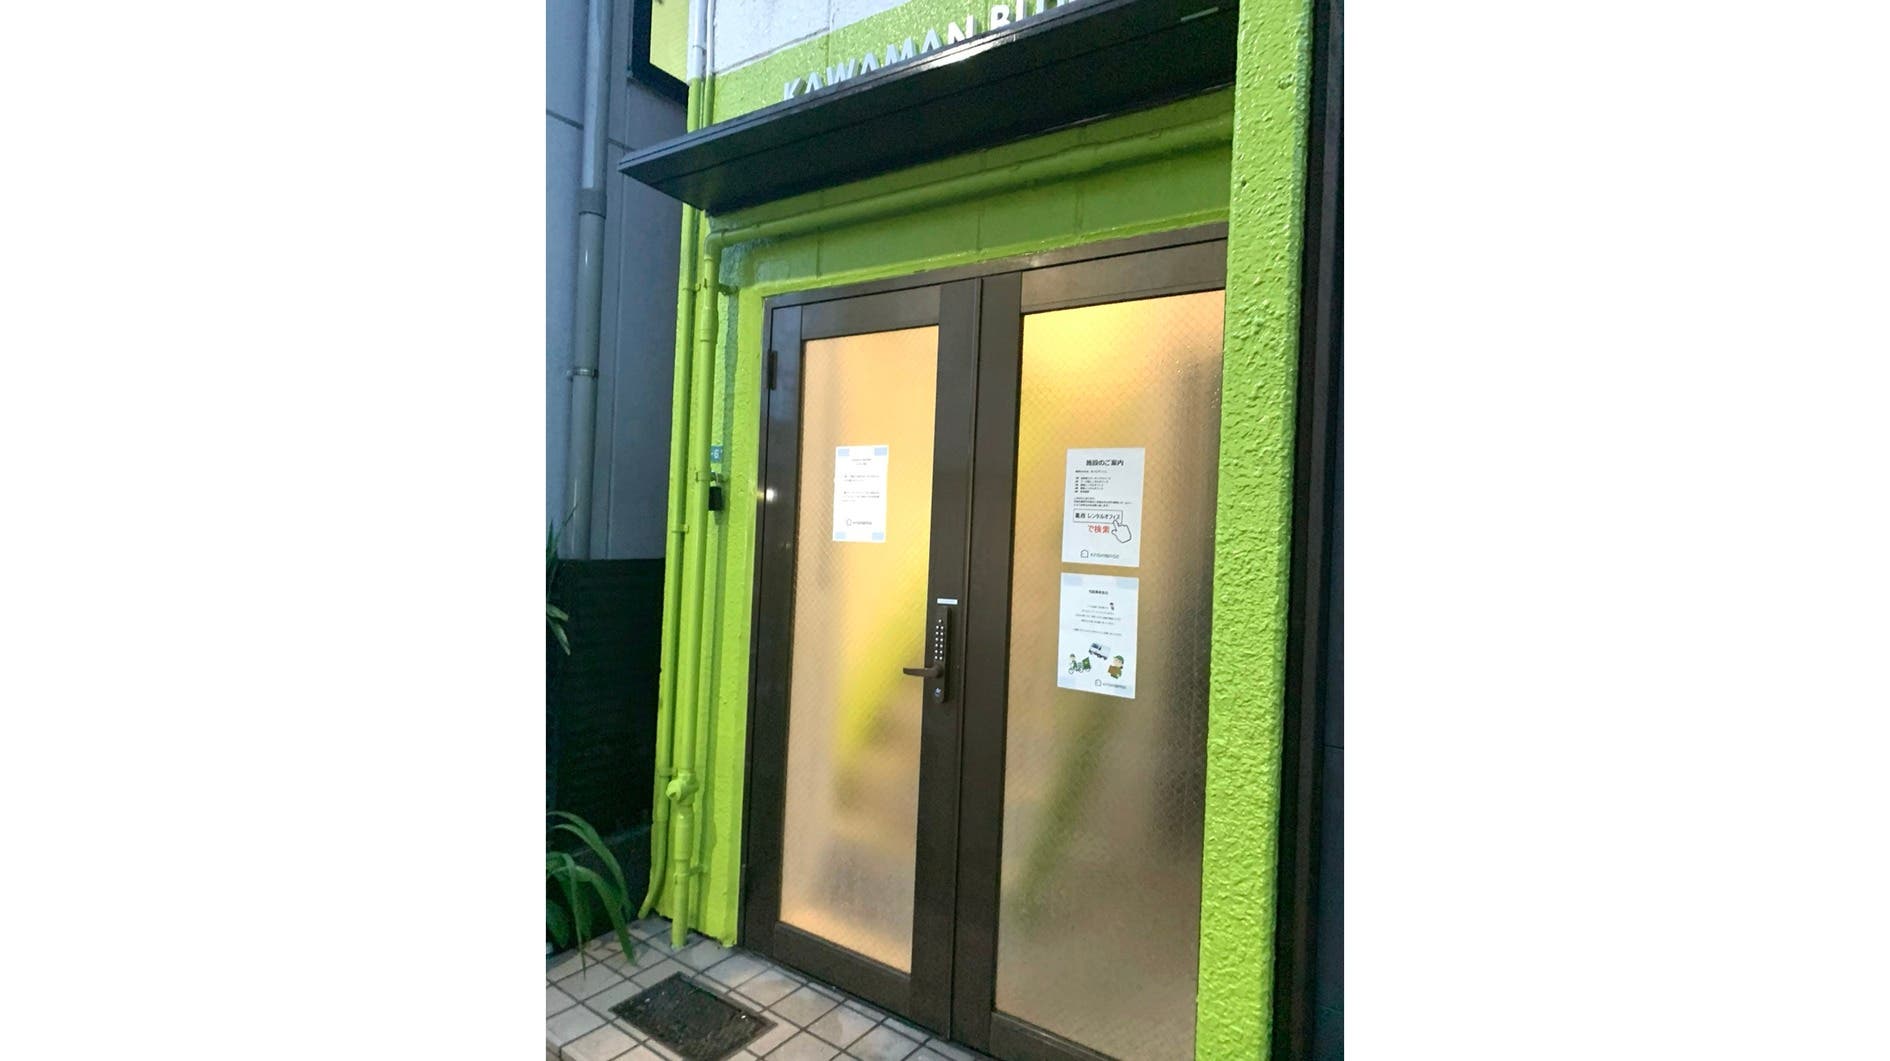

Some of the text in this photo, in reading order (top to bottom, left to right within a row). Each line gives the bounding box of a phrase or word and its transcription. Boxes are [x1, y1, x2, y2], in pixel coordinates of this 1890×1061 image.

[784, 15, 975, 101] KAWAMAN
[1086, 459, 1124, 467] 施設のご案内
[1087, 524, 1111, 534] で検索
